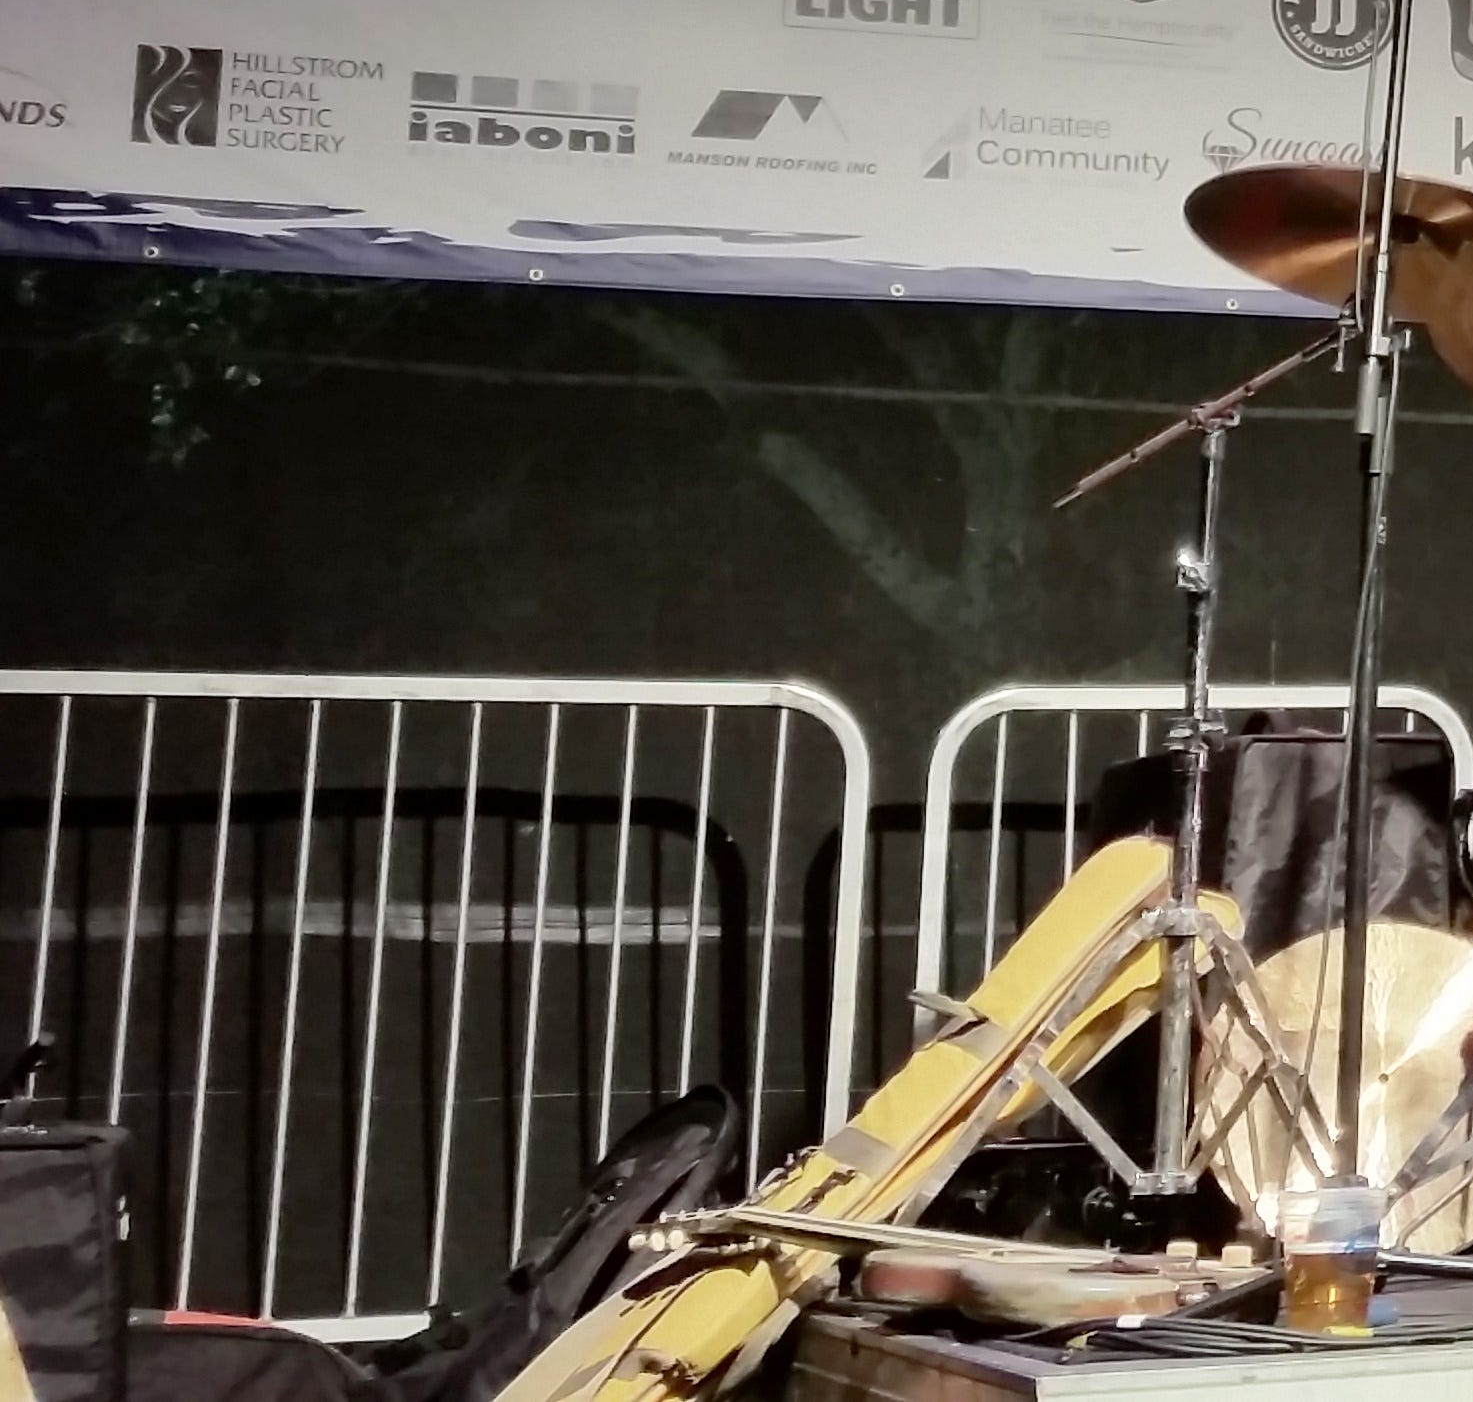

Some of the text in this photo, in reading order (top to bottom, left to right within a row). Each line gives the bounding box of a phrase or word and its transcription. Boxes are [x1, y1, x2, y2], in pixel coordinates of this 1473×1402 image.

[232, 52, 385, 81] HILLSTROM
[230, 77, 321, 102] FACIAL
[228, 103, 334, 129] PLASTIC
[978, 106, 1112, 139] Manatee
[225, 128, 345, 154] SURGERY
[408, 110, 636, 155] iaboni
[1202, 107, 1386, 164] Suncoa
[665, 150, 878, 175] MANSON ROOFING INC
[976, 139, 1170, 182] Community
